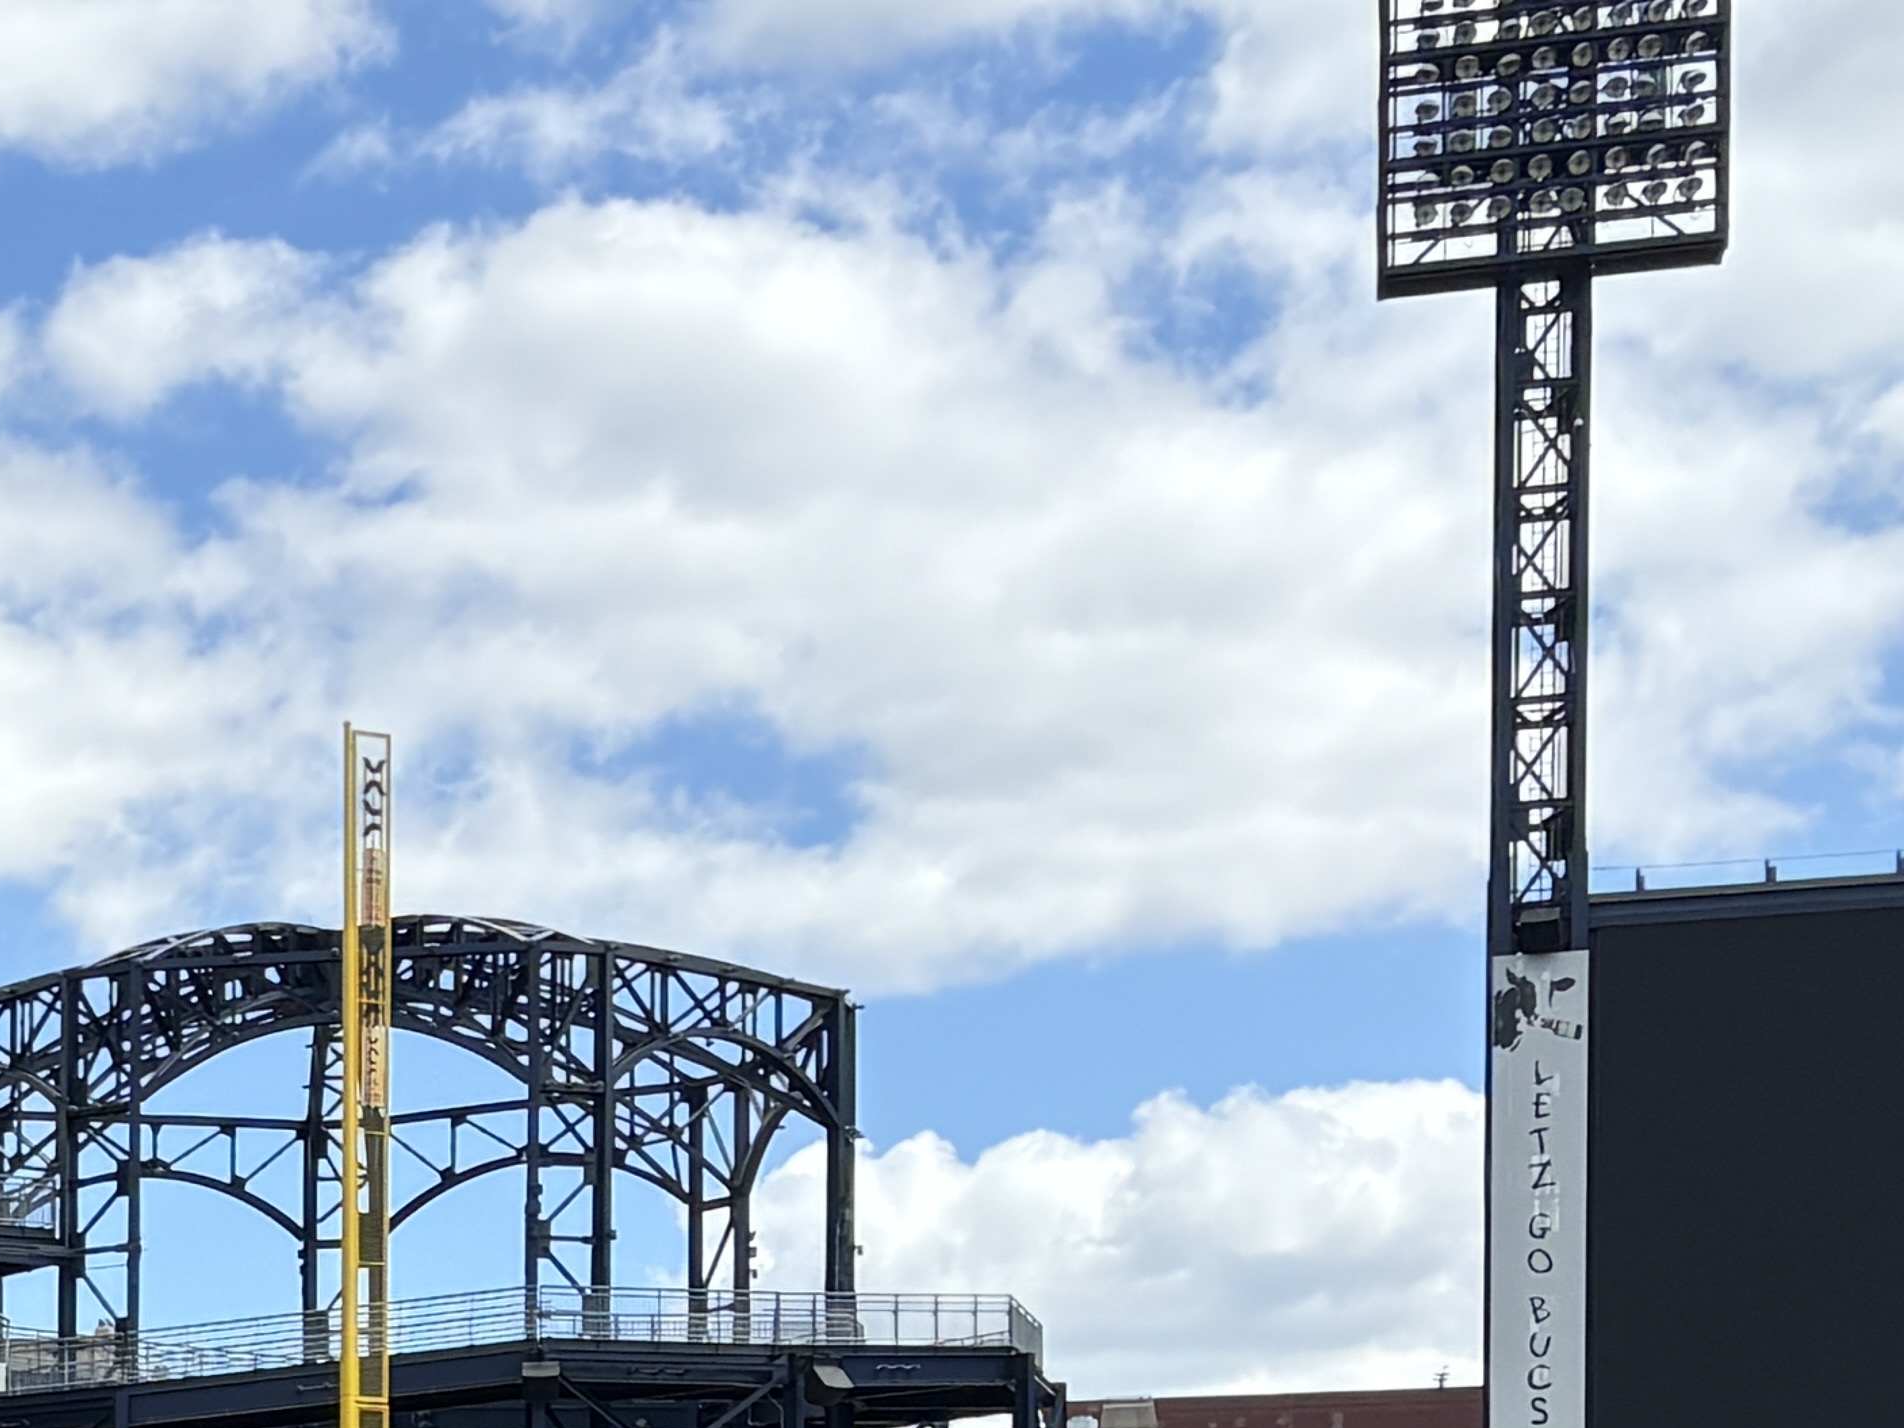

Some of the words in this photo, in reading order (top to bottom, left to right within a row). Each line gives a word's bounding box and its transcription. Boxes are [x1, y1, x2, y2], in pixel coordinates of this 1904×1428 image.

[1528, 1058, 1556, 1190] LETZ
[1527, 1212, 1553, 1274] GO
[1527, 1296, 1552, 1426] BUCS
